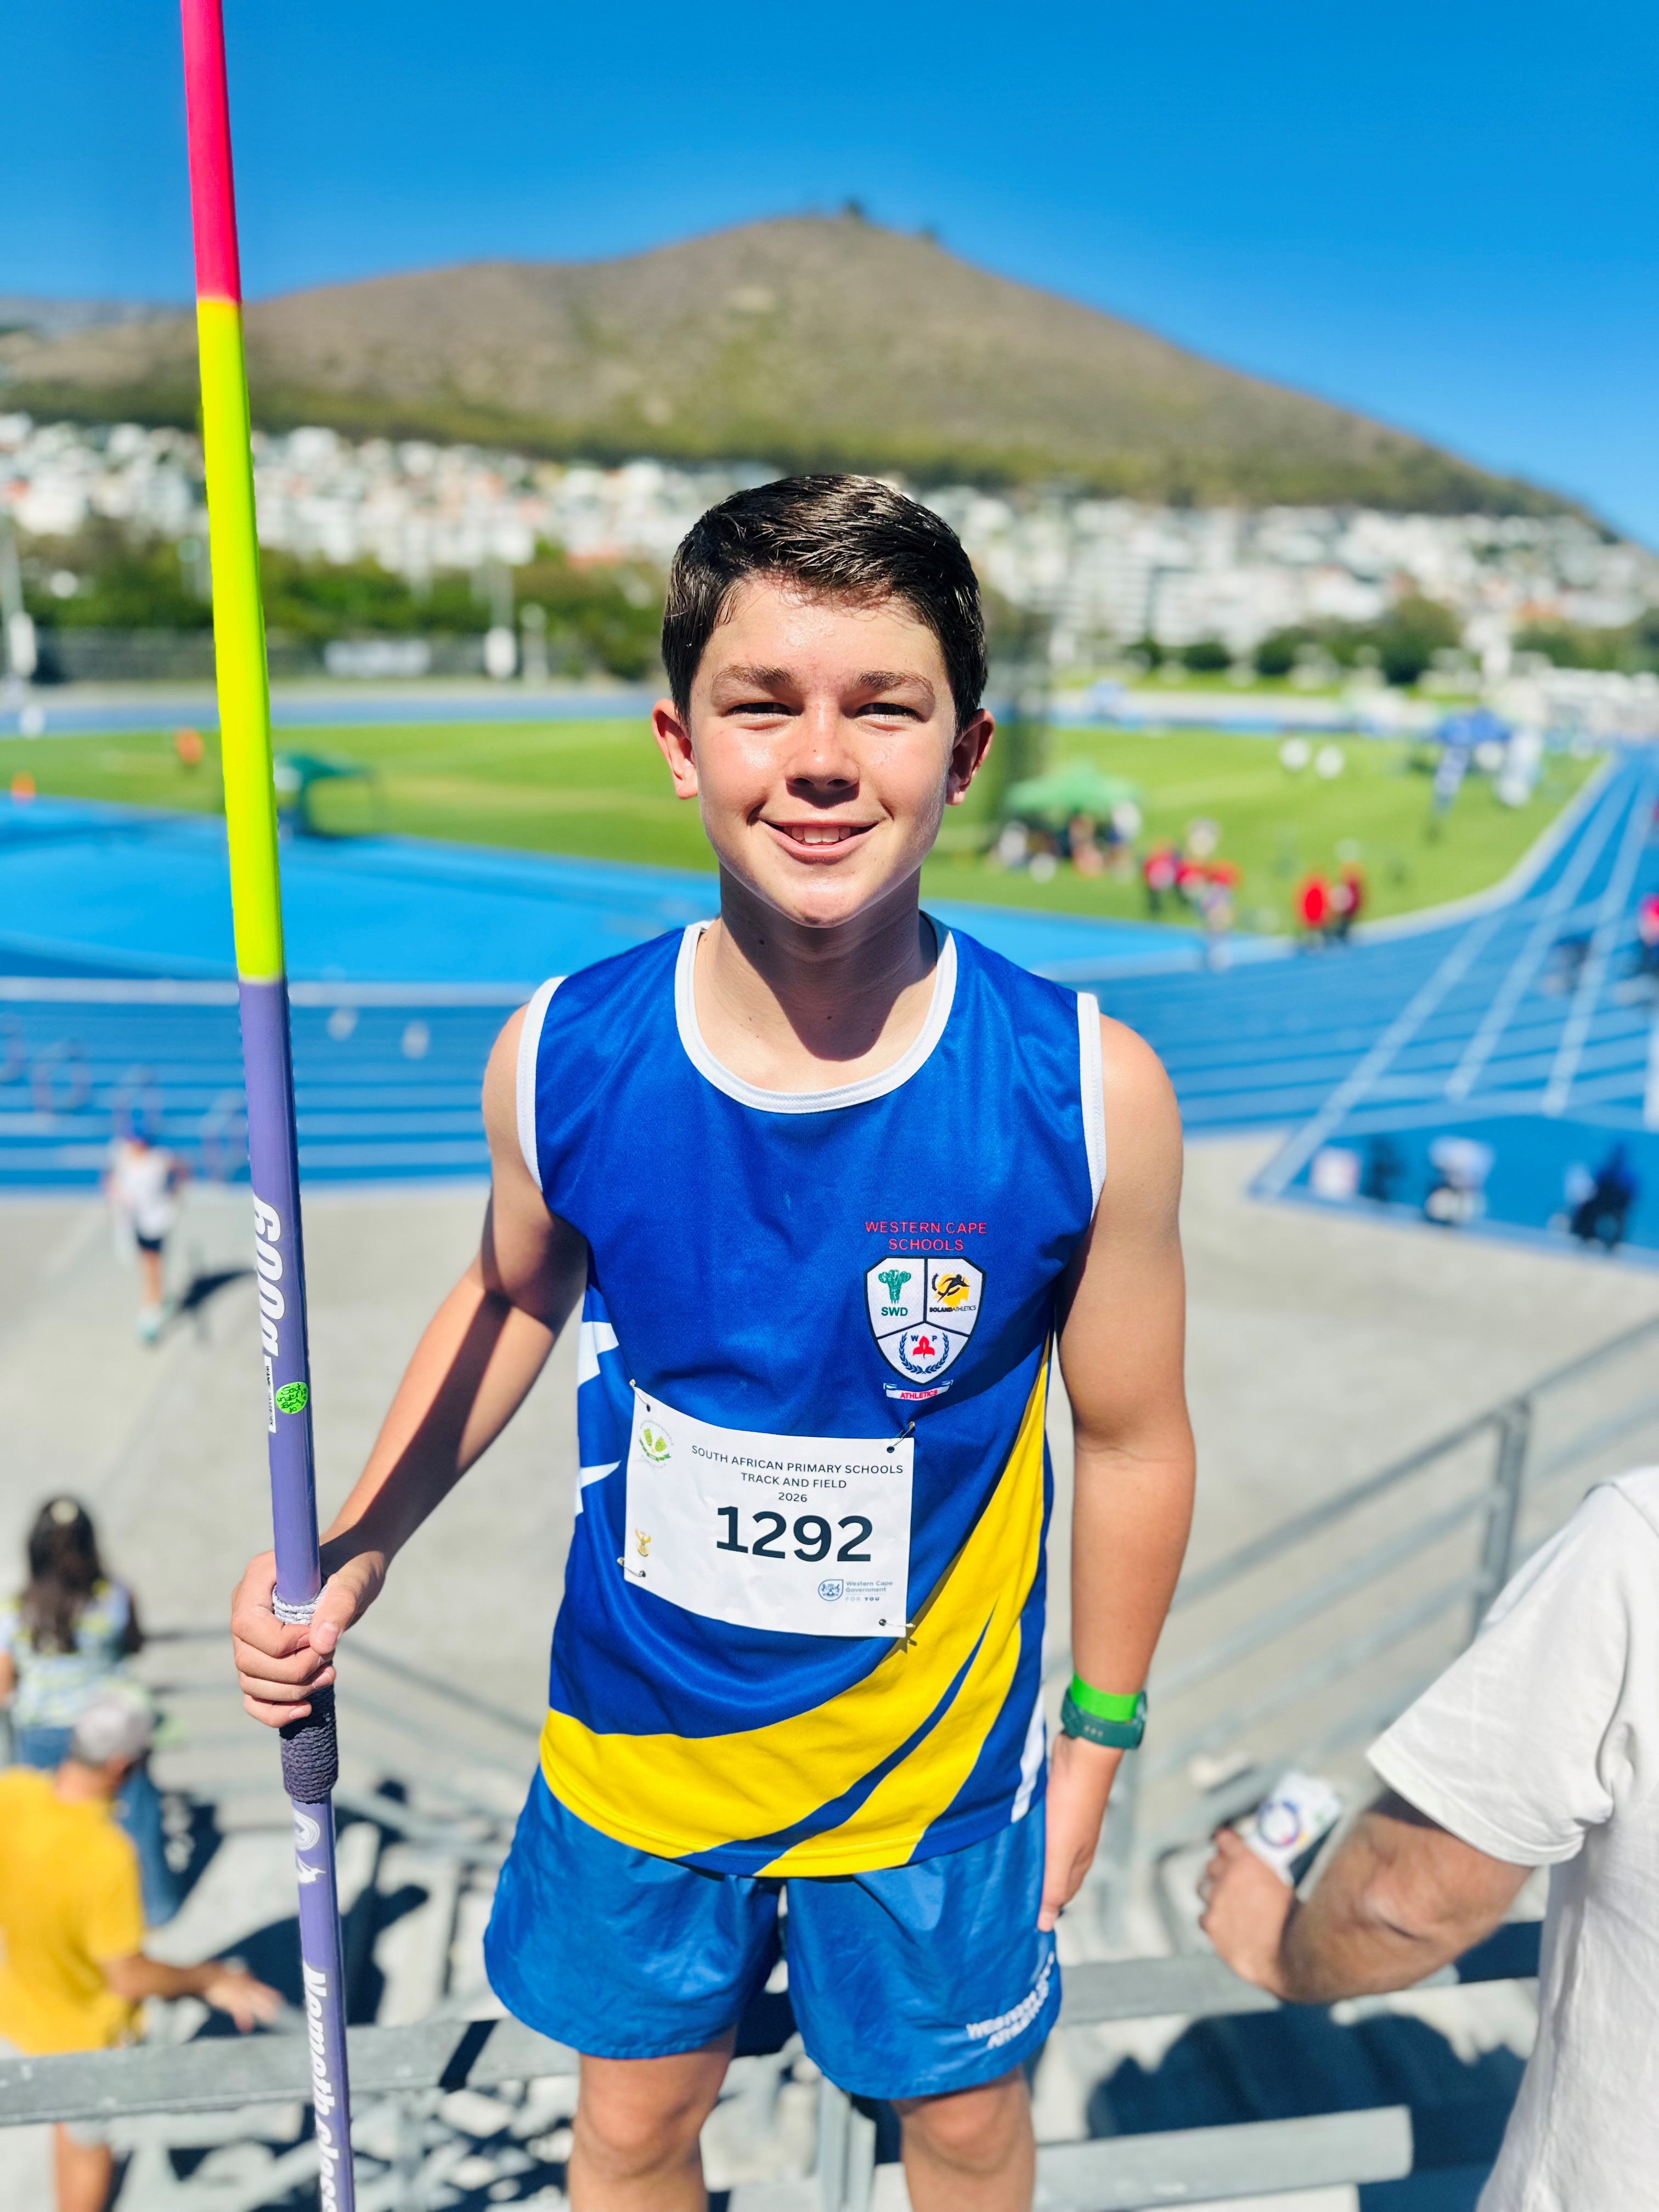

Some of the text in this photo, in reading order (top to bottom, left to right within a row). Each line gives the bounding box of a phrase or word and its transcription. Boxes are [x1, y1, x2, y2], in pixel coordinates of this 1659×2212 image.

[865, 1221, 988, 1234] WESTERN CAPE
[889, 1239, 963, 1251] SCHOOLS
[881, 1307, 908, 1316] SWD
[900, 1390, 938, 1399] ATHLETICS
[692, 1445, 903, 1474] SOUTH AFRICAN PRIMARY SCHOOLS
[741, 1472, 847, 1488] TRACK AND FIELD
[778, 1492, 808, 1503] 2026
[716, 1506, 873, 1562] 1292
